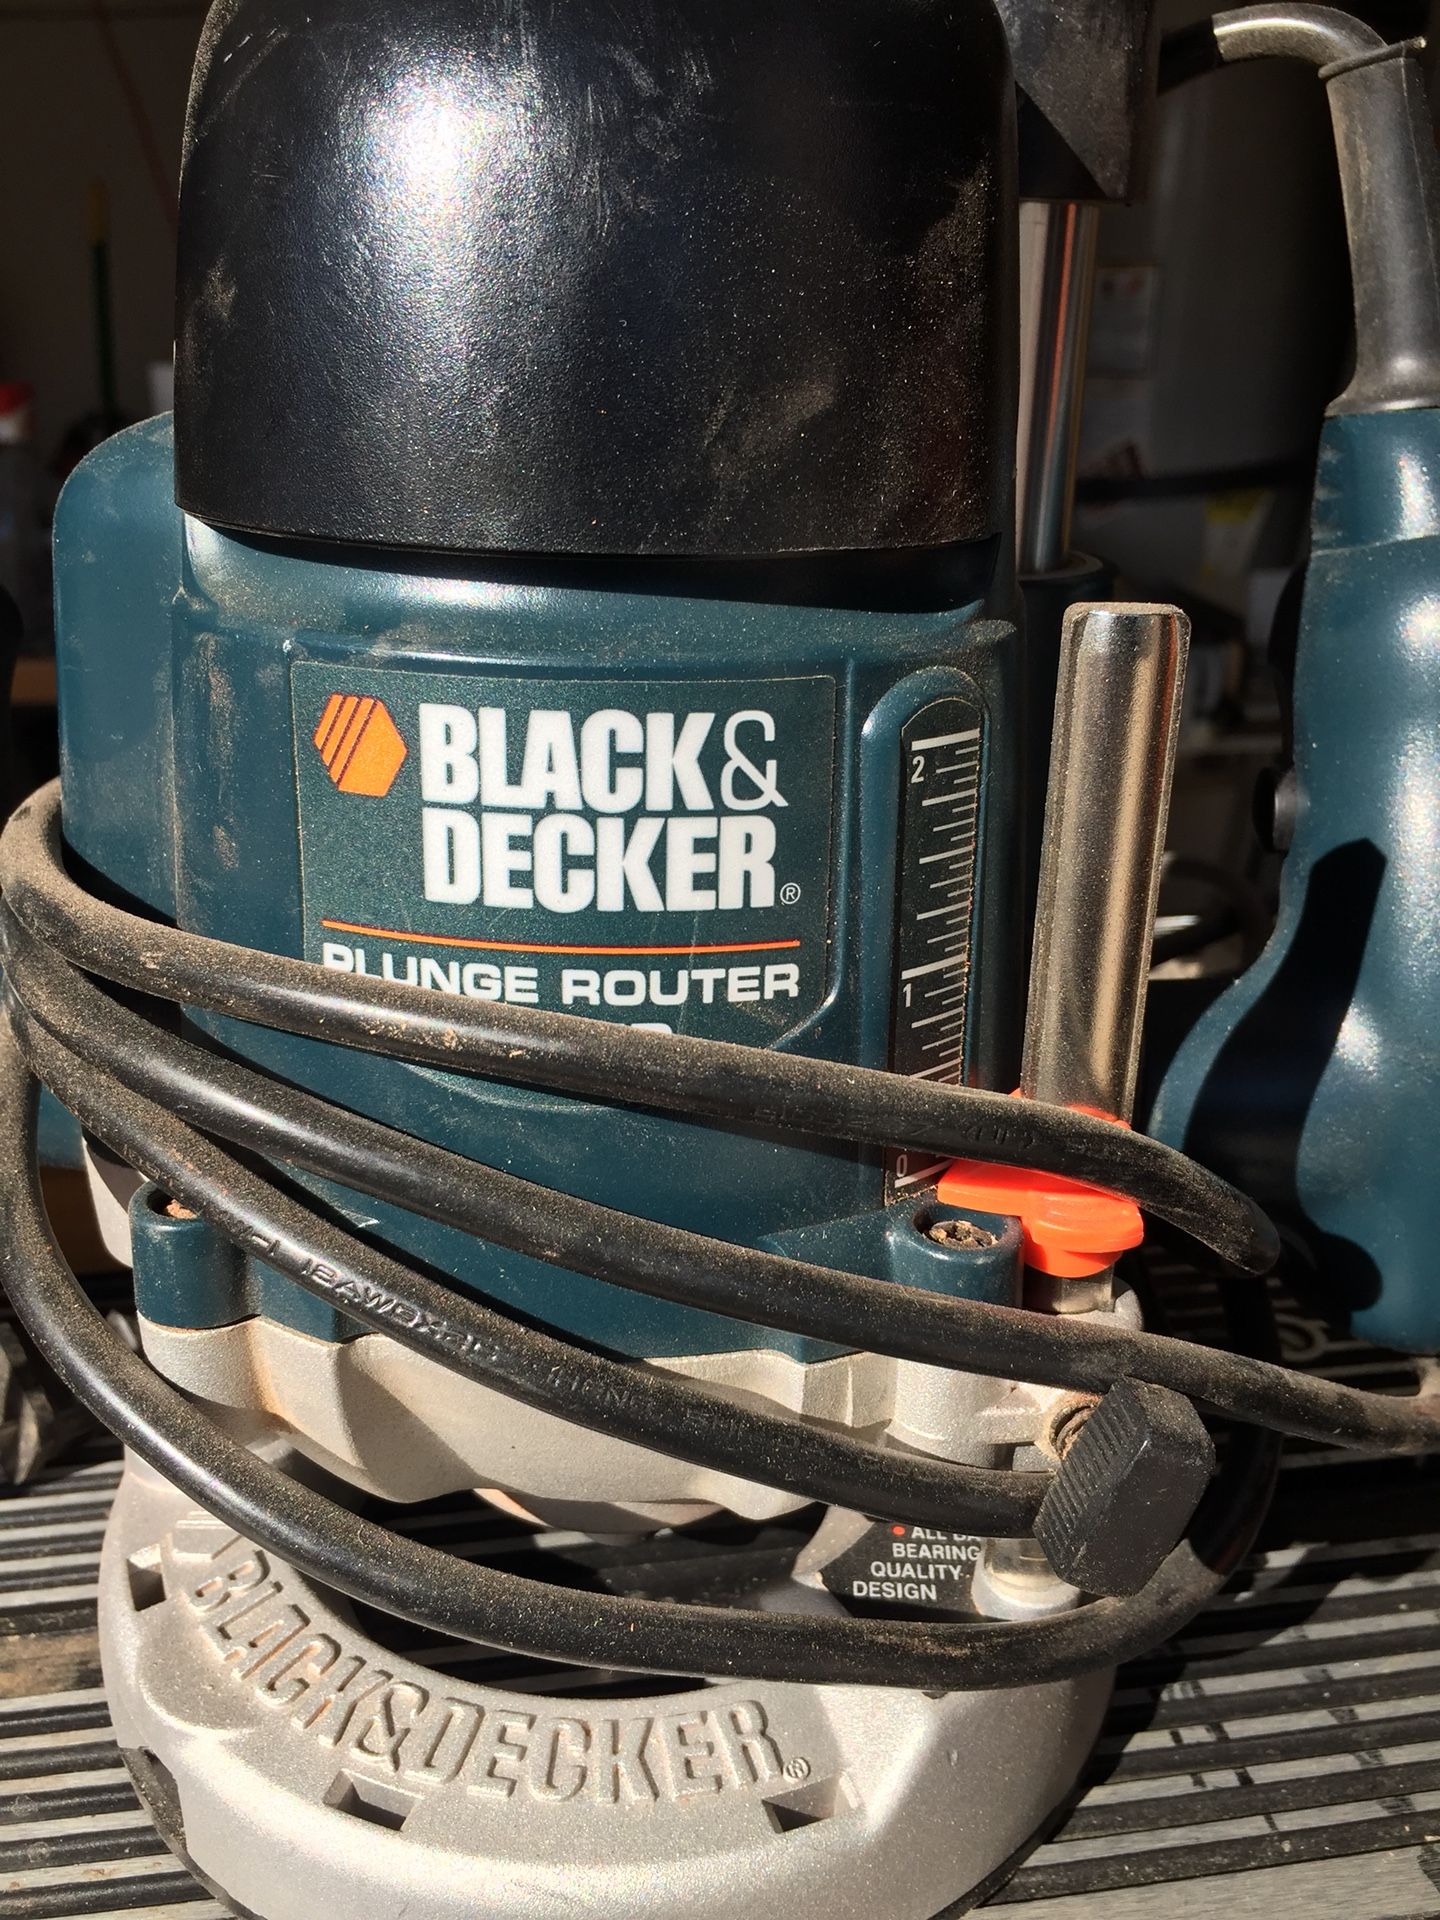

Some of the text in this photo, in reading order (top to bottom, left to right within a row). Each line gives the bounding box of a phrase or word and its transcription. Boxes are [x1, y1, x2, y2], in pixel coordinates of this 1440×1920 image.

[910, 755, 925, 784] 2
[321, 942, 799, 1006] PLUNGE ROUTER
[902, 982, 912, 1008] 1
[896, 1152, 908, 1178] 0
[892, 1542, 981, 1561] BEARING
[870, 1561, 963, 1581] QUALITY
[853, 1581, 937, 1600] DESIGN
